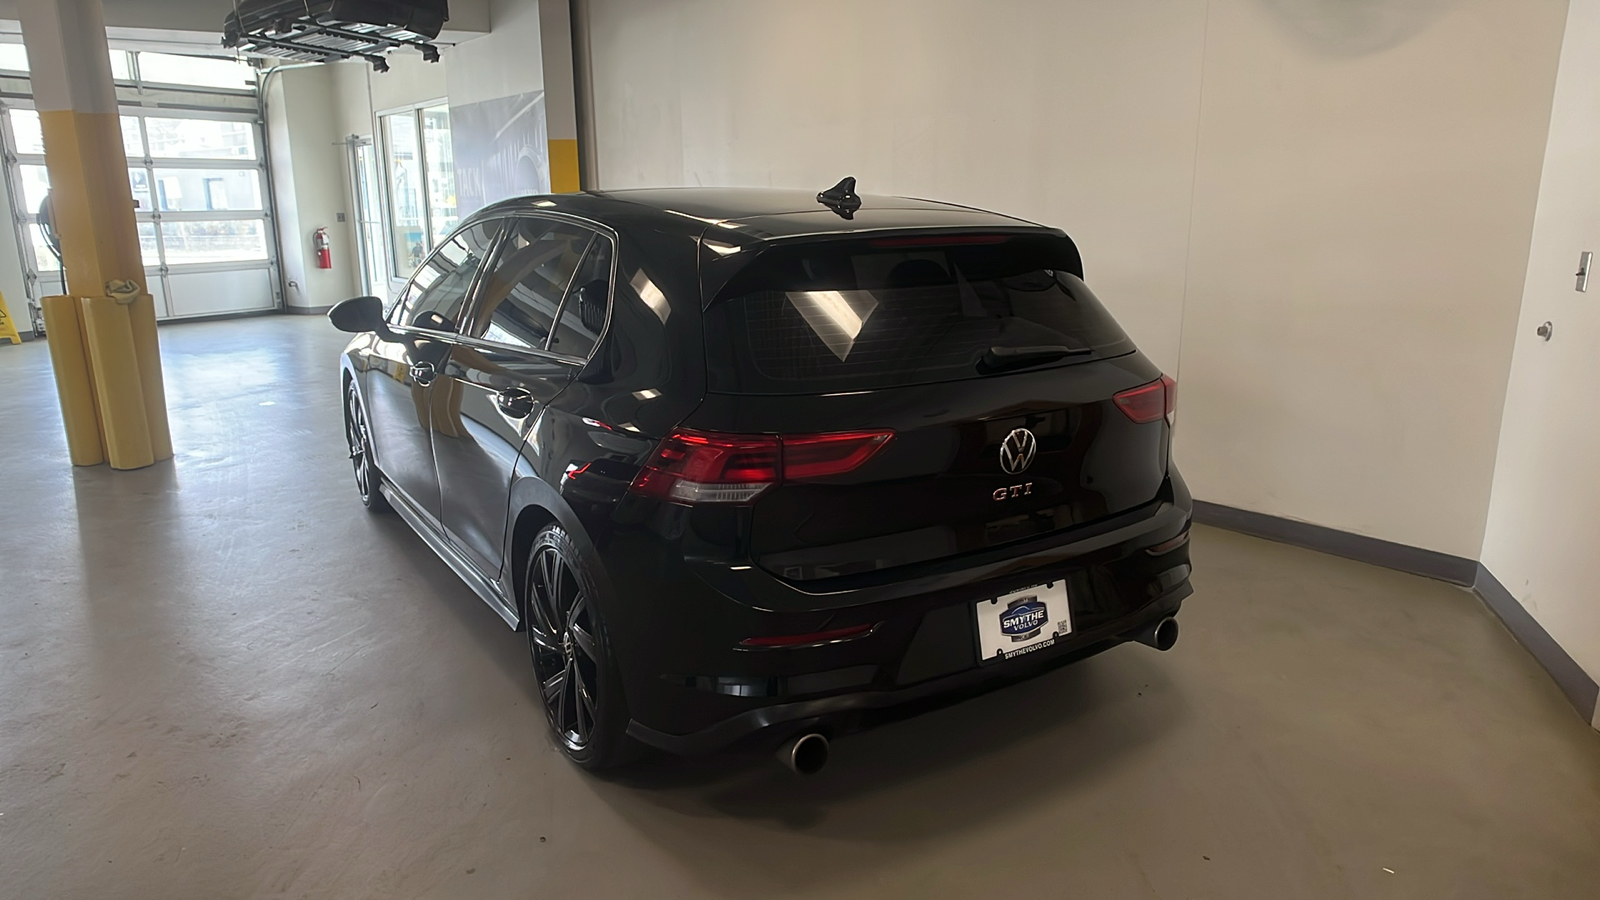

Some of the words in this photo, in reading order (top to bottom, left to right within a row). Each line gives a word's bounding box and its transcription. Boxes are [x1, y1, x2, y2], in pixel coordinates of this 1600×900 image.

[1000, 428, 1037, 475] VW
[993, 482, 1033, 501] GTI
[1003, 610, 1044, 629] SMYTHE
[1014, 620, 1039, 631] VOLVO
[1004, 639, 1055, 660] SMYTHEVOLVO.COM
